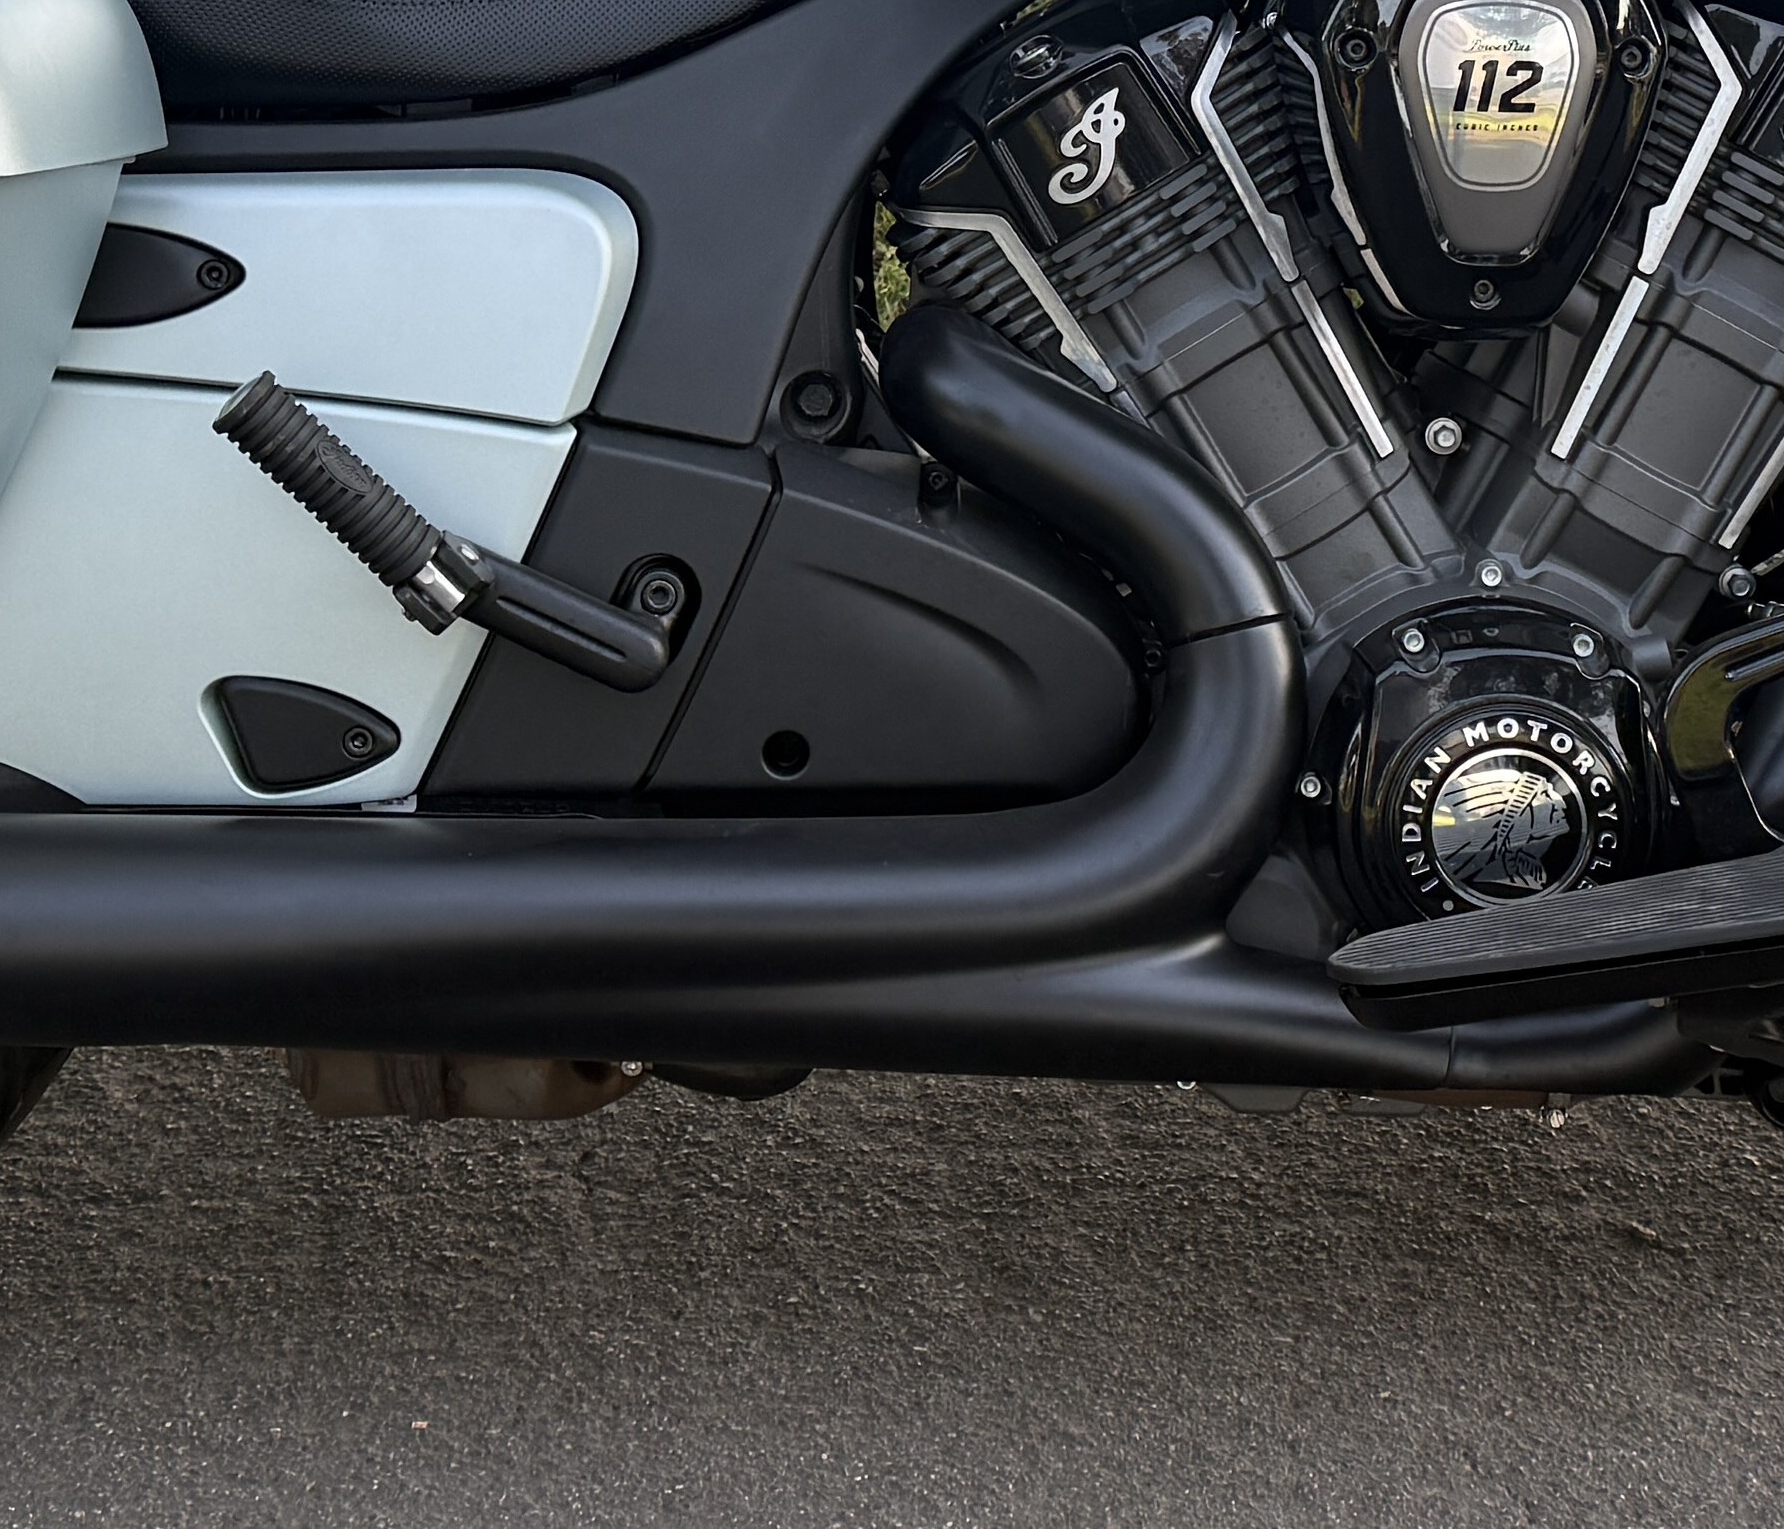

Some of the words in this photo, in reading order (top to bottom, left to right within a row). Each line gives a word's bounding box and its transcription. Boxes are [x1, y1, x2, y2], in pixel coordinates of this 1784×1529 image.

[1453, 59, 1544, 113] 112
[1456, 122, 1490, 132] CUBIC
[1402, 747, 1452, 893] INDIAN
